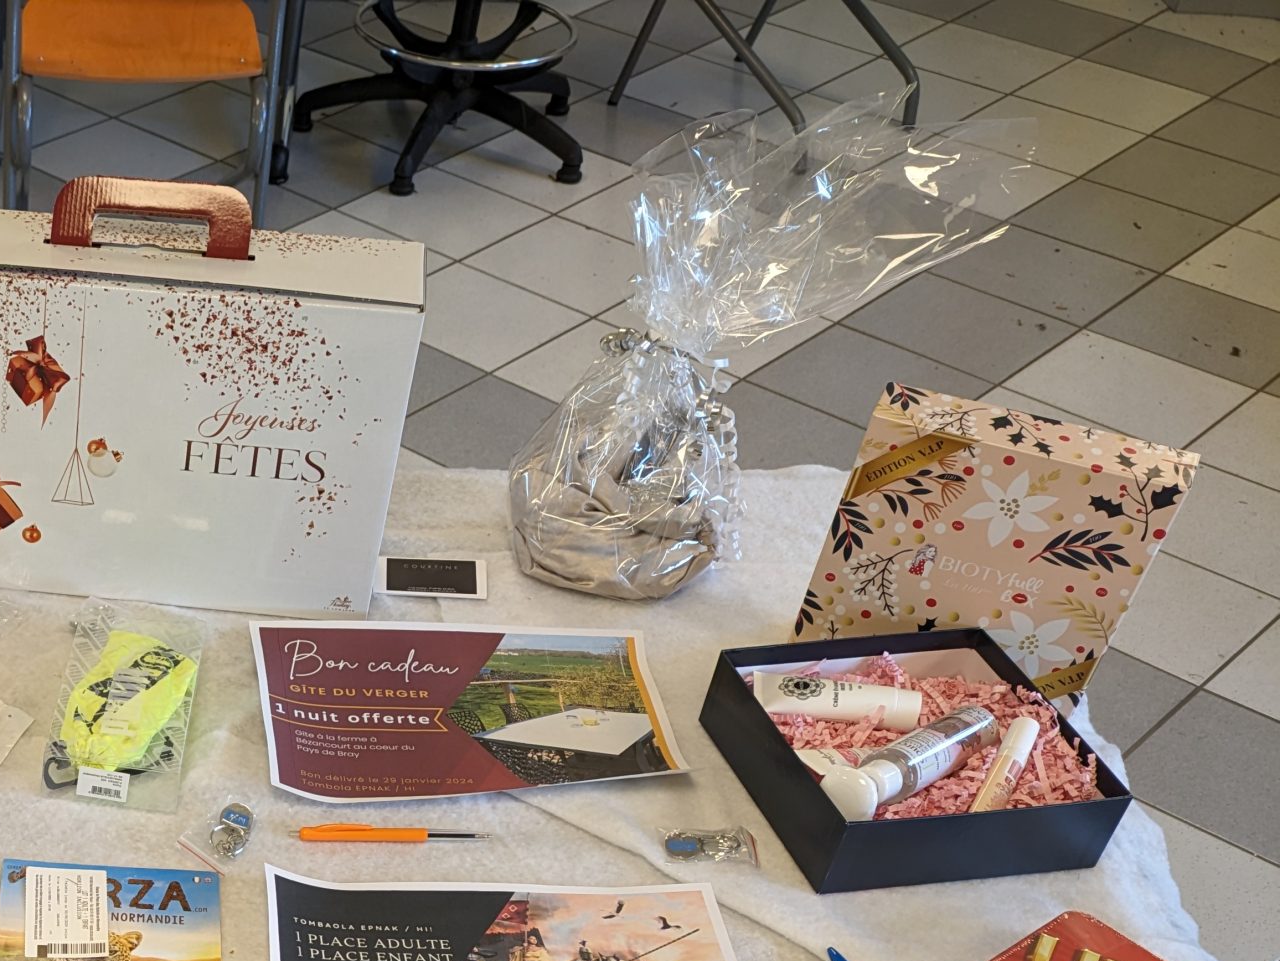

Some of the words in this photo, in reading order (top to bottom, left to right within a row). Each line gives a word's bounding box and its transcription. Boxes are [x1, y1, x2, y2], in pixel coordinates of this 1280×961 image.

[198, 396, 320, 441] Joyeuses
[180, 436, 327, 484] FÊTES
[865, 451, 916, 484] ÉDITION
[284, 639, 359, 680] Bon
[368, 648, 460, 683] cadeau
[289, 684, 326, 696] GÎTE
[333, 687, 356, 697] DU
[362, 688, 429, 699] VERGER
[275, 702, 286, 715] 1
[294, 710, 340, 724] nuit
[348, 712, 431, 725] offerte
[337, 735, 368, 743] ferme
[297, 744, 319, 756] Pays
[321, 748, 335, 756] de
[337, 751, 360, 760] Bray
[300, 769, 321, 779] Bon
[368, 776, 379, 784] le
[302, 778, 353, 791] Tombola
[111, 912, 185, 925] NORMANDIE
[293, 917, 355, 930] TOMBAOLA
[360, 924, 399, 932] EPNAK
[308, 933, 368, 948] PLACE
[374, 938, 451, 950] ADULTE
[310, 948, 370, 961] PLACE
